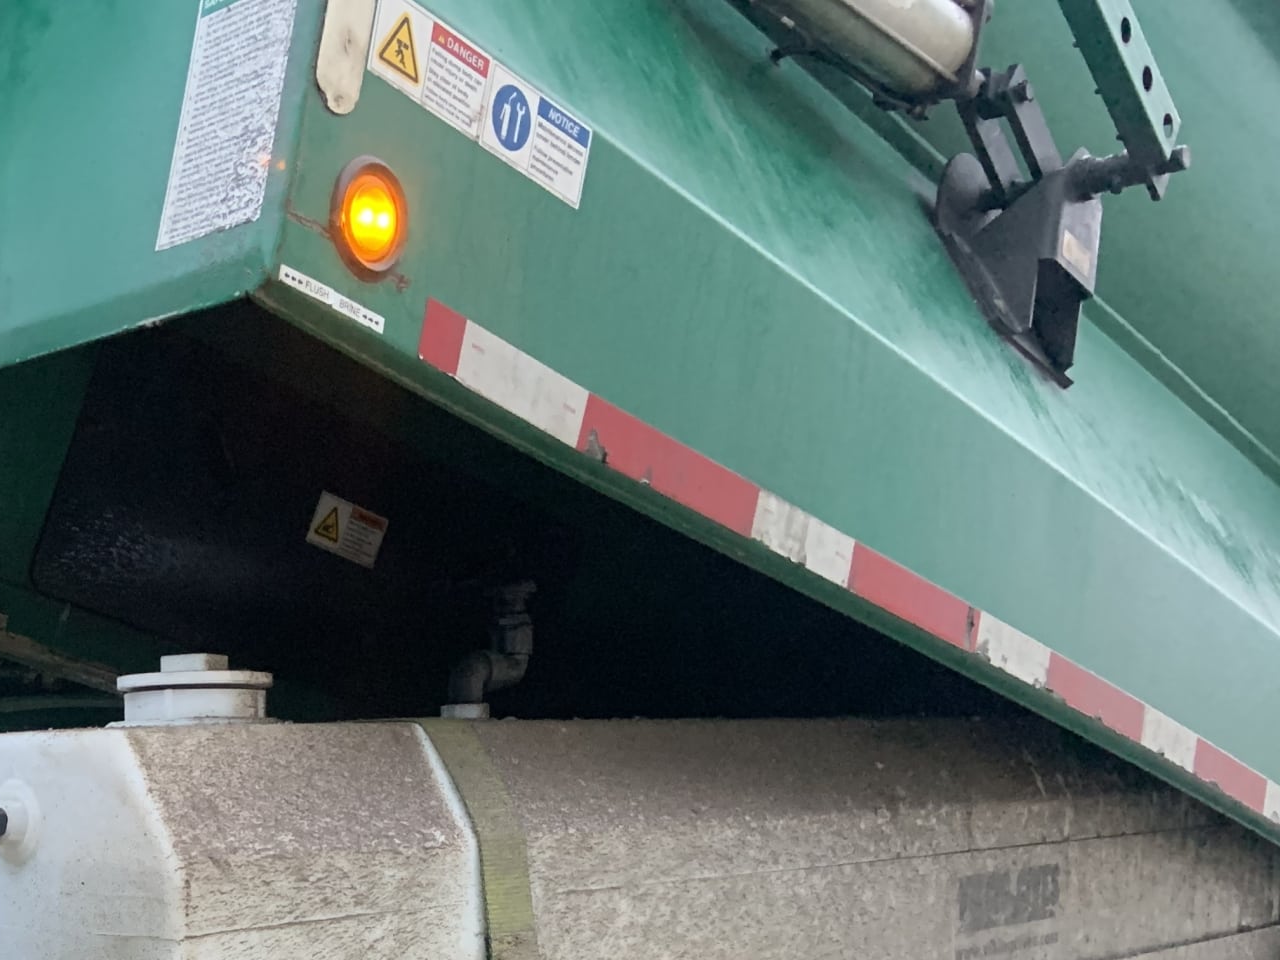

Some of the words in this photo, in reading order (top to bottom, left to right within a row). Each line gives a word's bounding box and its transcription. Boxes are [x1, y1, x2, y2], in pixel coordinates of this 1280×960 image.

[446, 35, 484, 71] DANGER
[547, 106, 580, 138] NOTICE
[305, 281, 329, 299] FLUSH
[339, 299, 360, 317] BRINE
